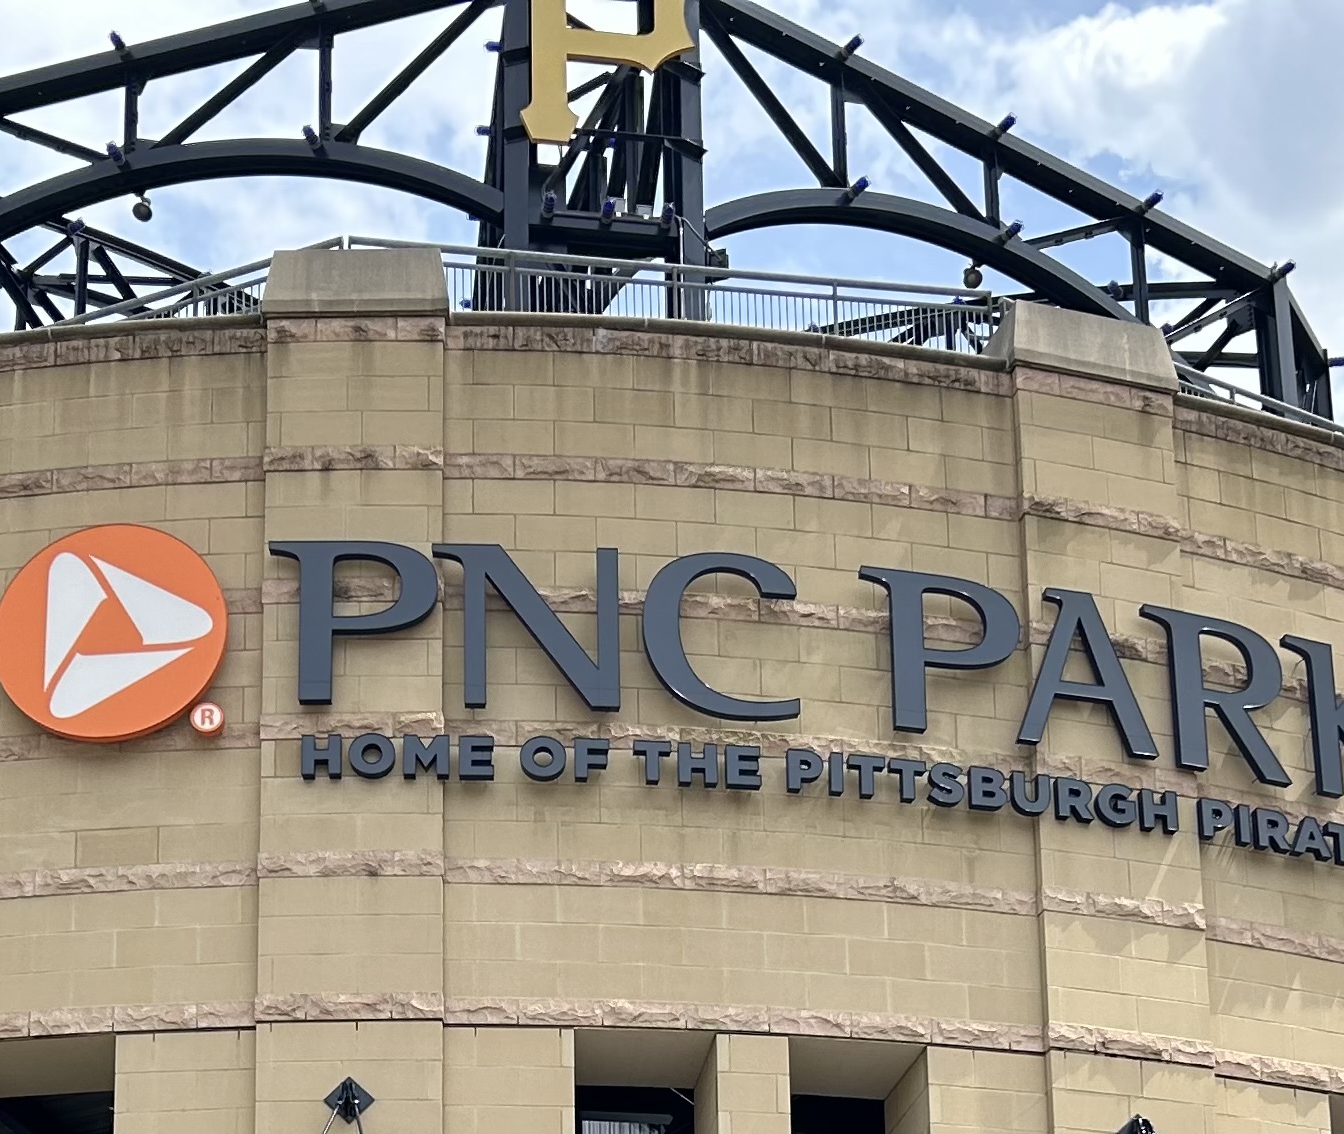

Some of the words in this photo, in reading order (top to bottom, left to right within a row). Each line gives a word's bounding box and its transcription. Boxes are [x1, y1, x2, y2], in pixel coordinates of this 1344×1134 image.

[268, 540, 801, 721] PNC
[301, 732, 495, 781] HOME
[520, 735, 610, 783] OF
[633, 739, 763, 790] THE
[786, 748, 1179, 834] PITTSBURGH
